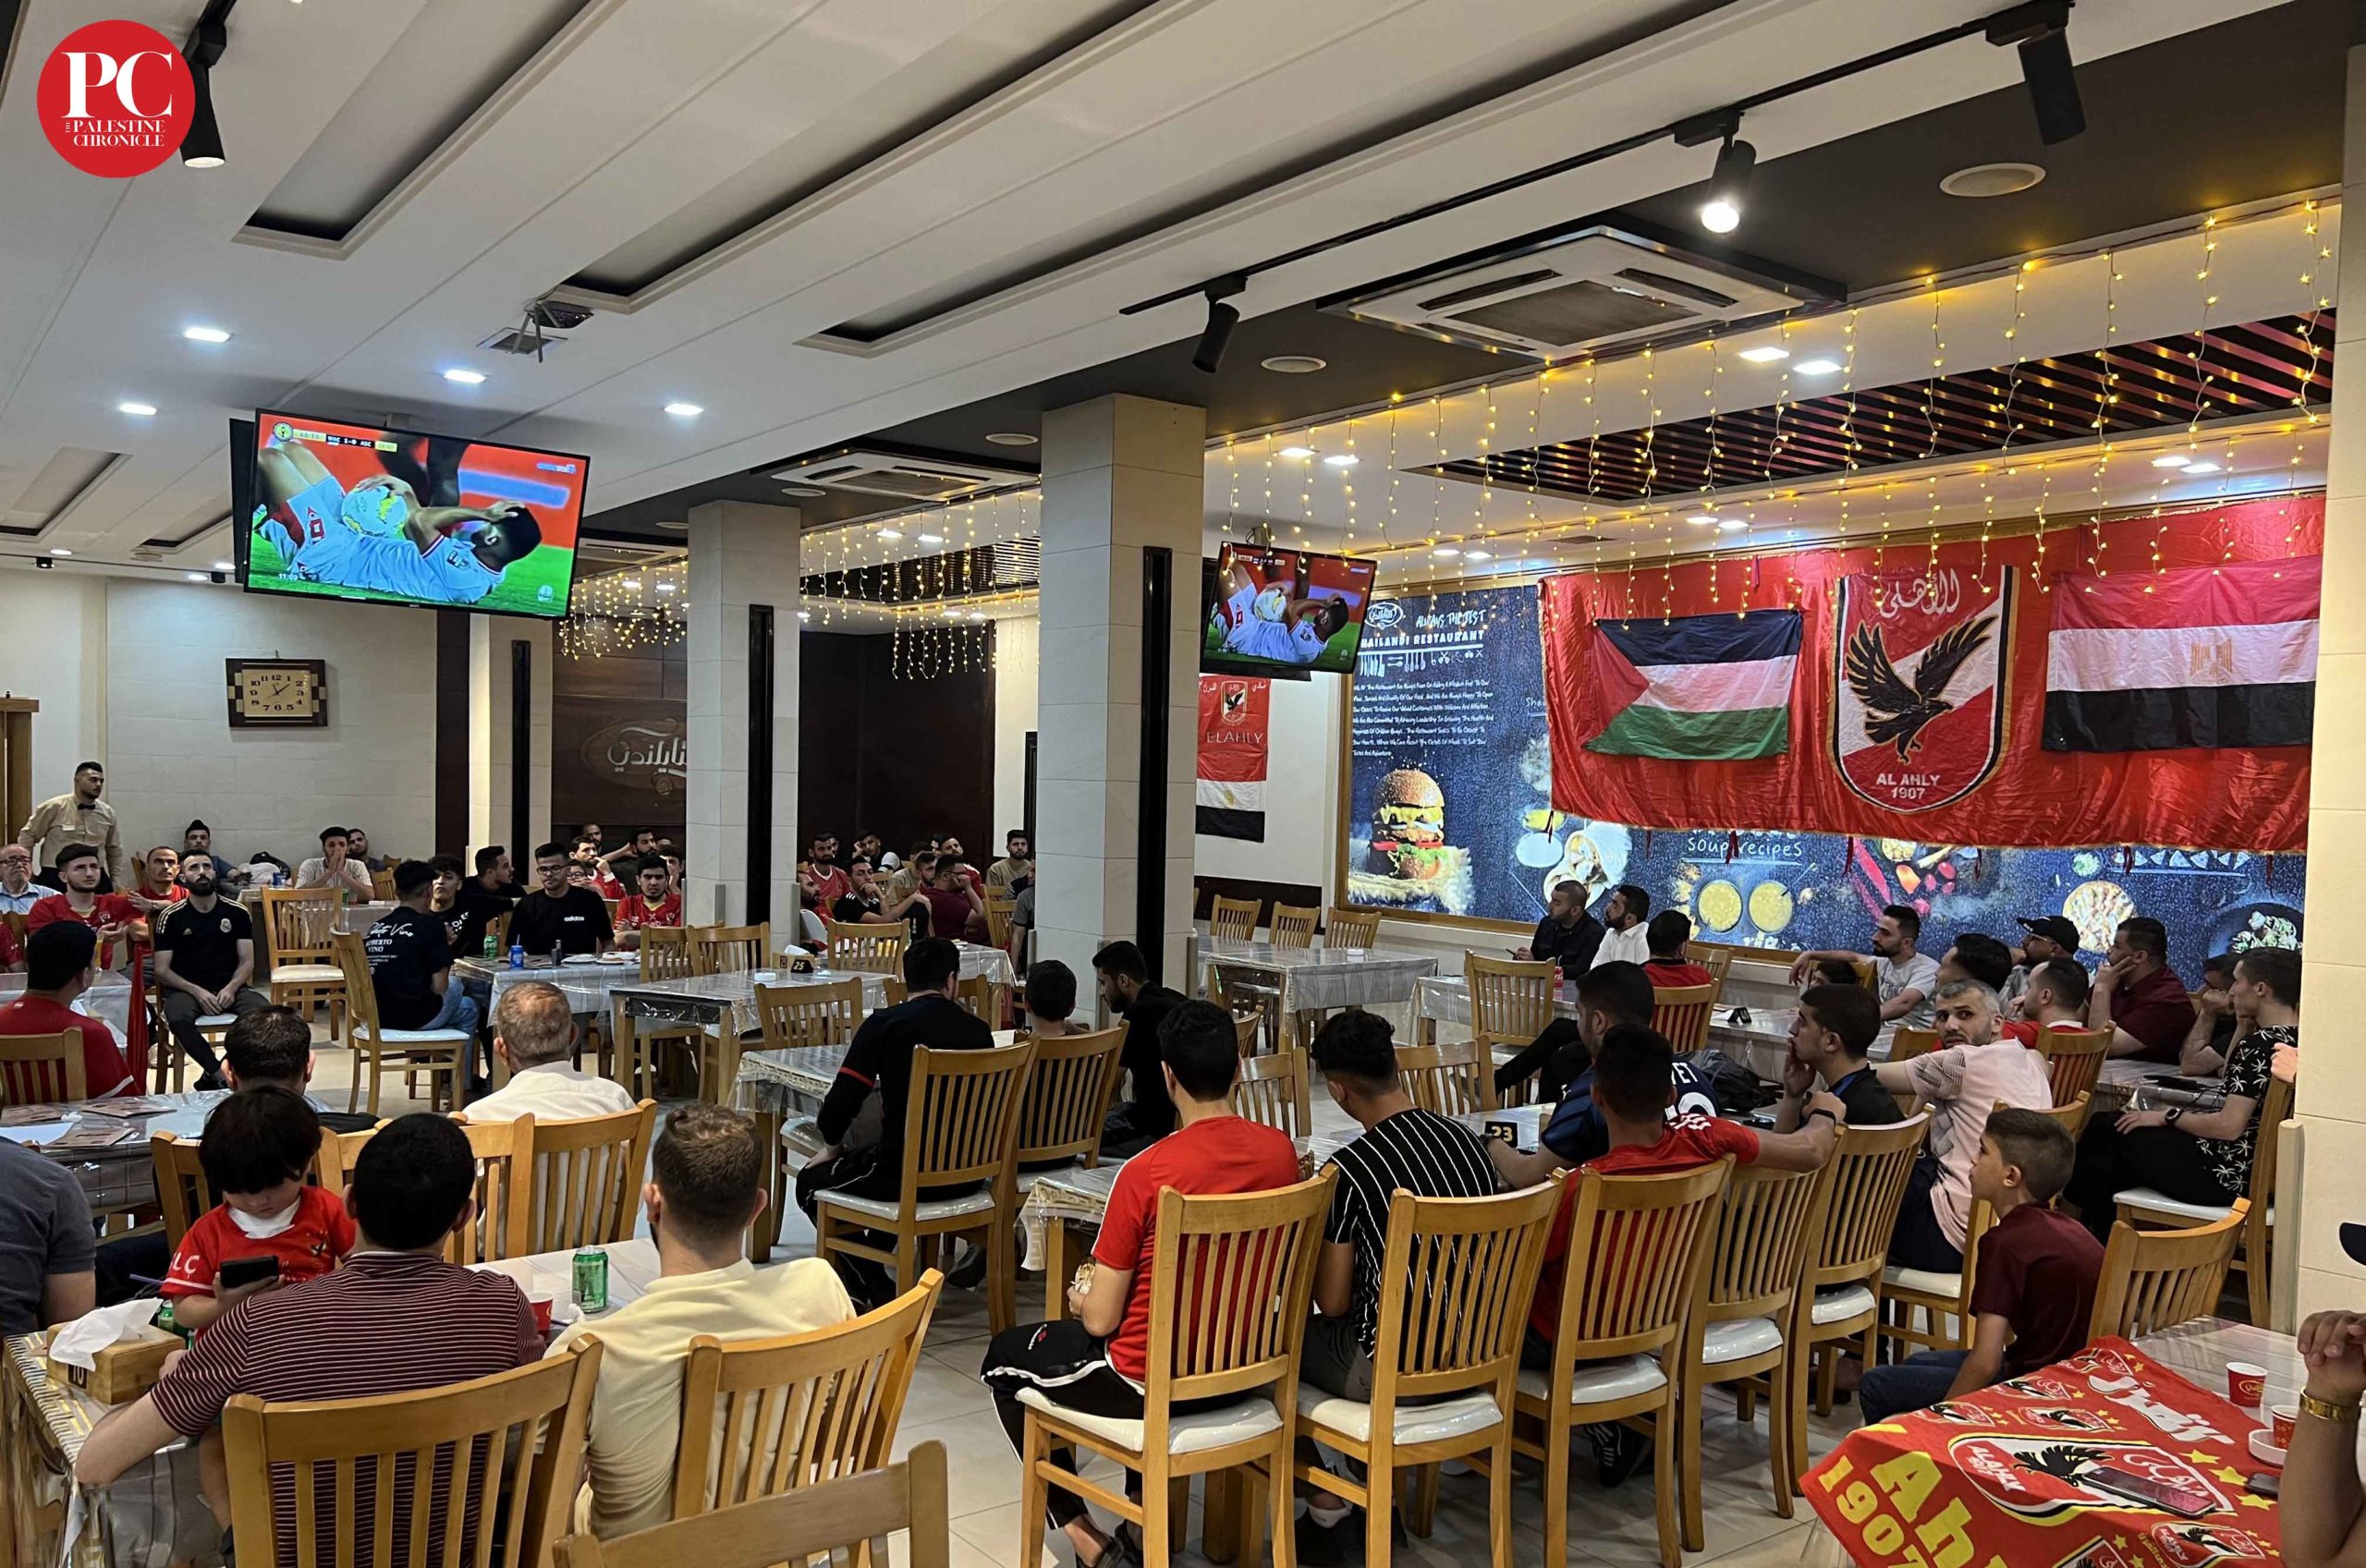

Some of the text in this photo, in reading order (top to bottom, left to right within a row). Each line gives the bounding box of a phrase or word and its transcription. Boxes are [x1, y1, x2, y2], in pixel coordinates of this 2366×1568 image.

[1413, 630, 1484, 645] RESTAURANT
[1206, 731, 1264, 745] ELAHLY
[1876, 772, 1941, 787] AL AHLY
[1891, 787, 1926, 800] 1907
[1687, 836, 1803, 862] soup recipes
[793, 961, 805, 970] 25
[1490, 1124, 1514, 1142] 23
